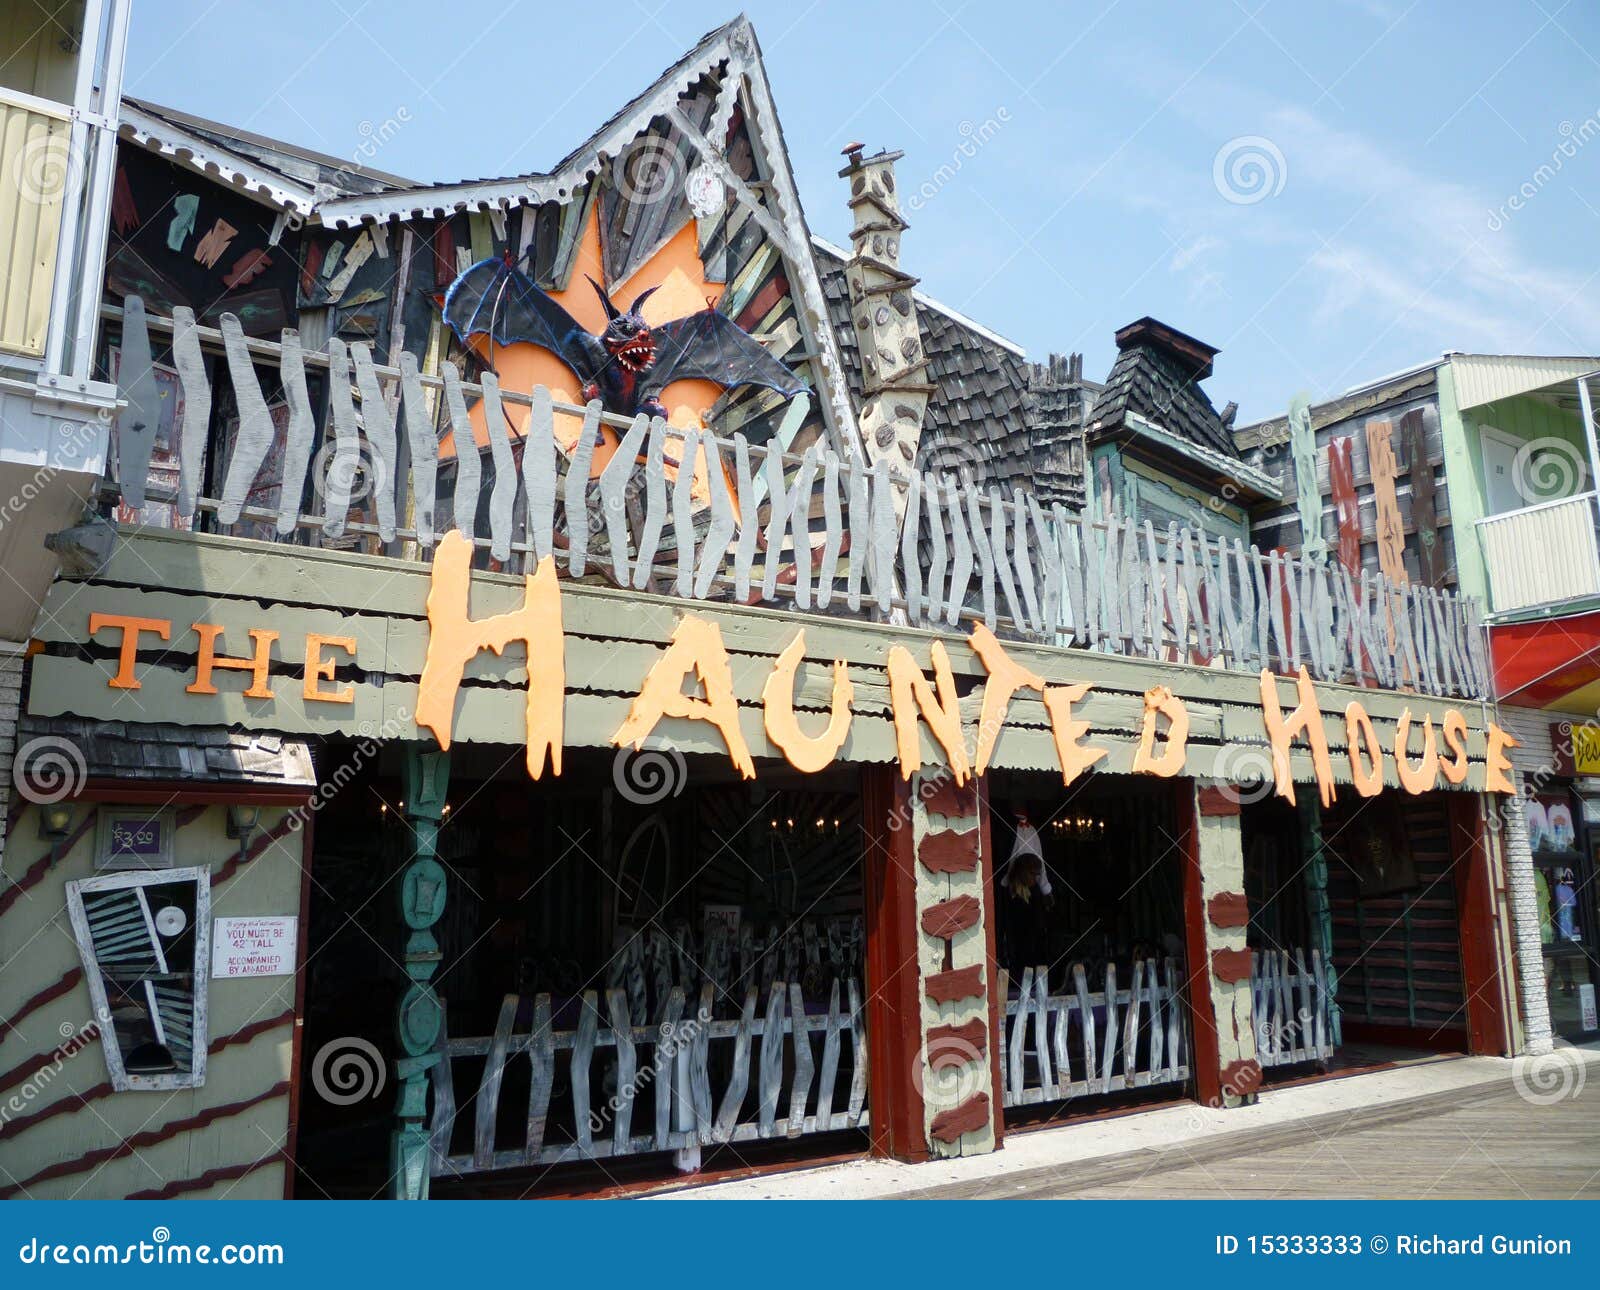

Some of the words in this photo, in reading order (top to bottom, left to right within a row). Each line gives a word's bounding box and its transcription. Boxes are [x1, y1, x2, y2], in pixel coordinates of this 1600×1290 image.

[89, 612, 359, 704] THE
[415, 528, 1189, 782] HAUNTED
[1260, 664, 1521, 808] HOUSE
[227, 929, 244, 939] YOU
[248, 929, 270, 938] MUST
[273, 928, 284, 937] BE
[251, 939, 275, 948] TALL
[228, 956, 281, 965] ACCOMPANIED
[229, 966, 238, 974] BY
[256, 965, 278, 973] ADULT
